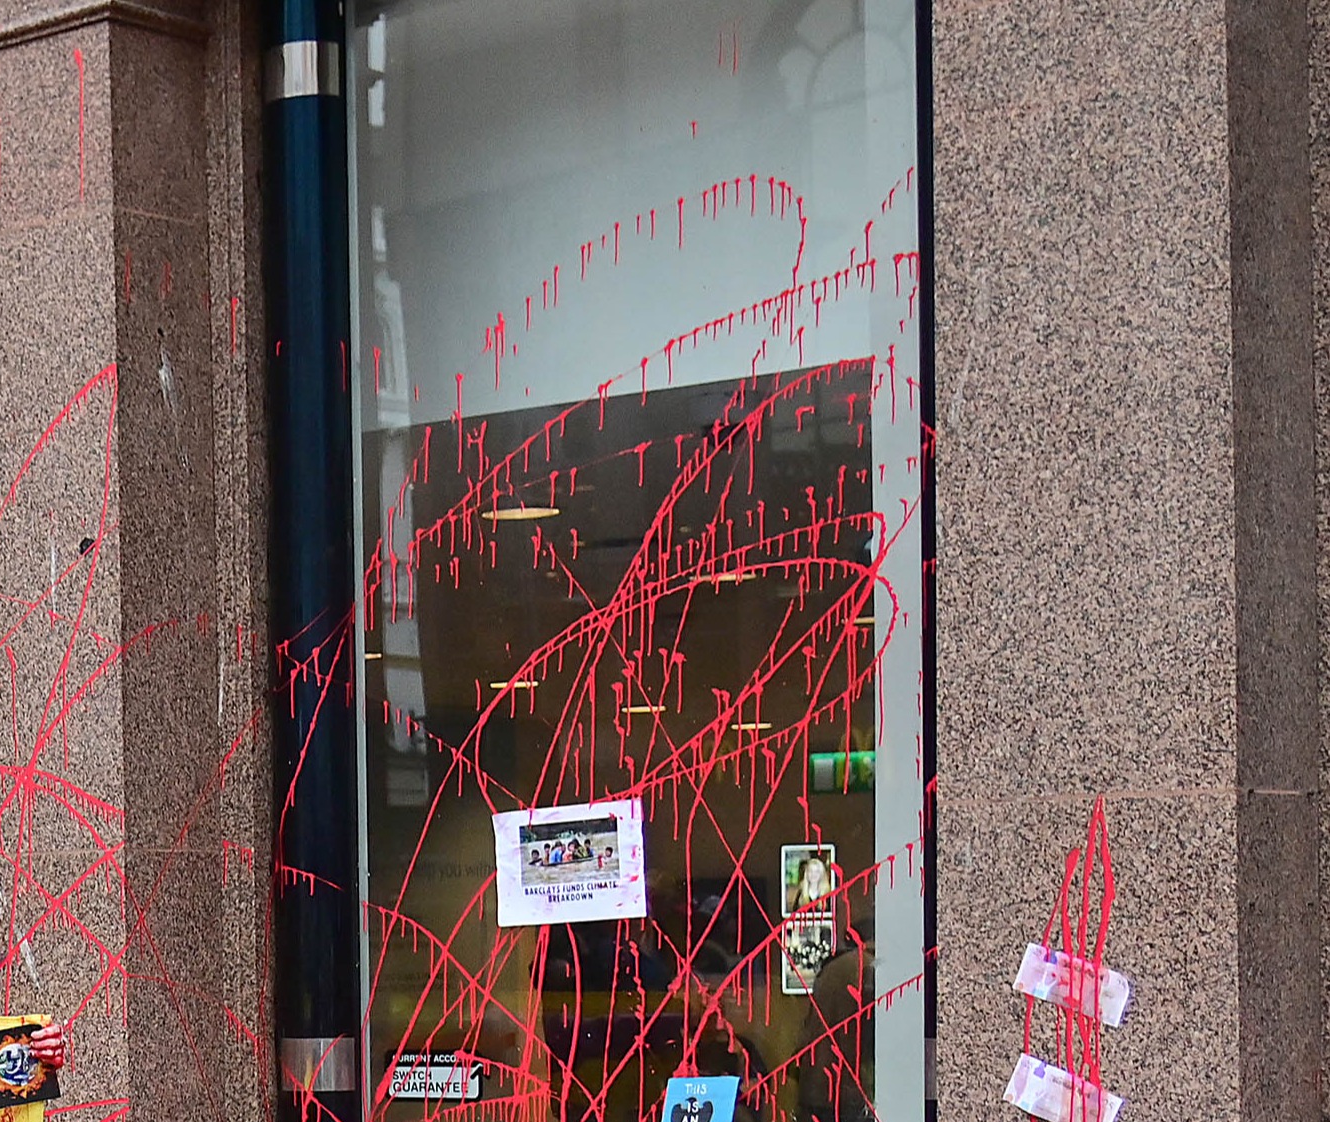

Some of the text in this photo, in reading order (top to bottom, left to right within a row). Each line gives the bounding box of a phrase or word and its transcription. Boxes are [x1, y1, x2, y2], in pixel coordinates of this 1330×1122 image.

[525, 884, 560, 896] BARCLAYS
[587, 880, 618, 891] CLIMATE
[548, 892, 593, 903] BREAKDOWN
[393, 1071, 432, 1080] SWITCH
[685, 1083, 707, 1095] THIS
[687, 1101, 699, 1113] IS
